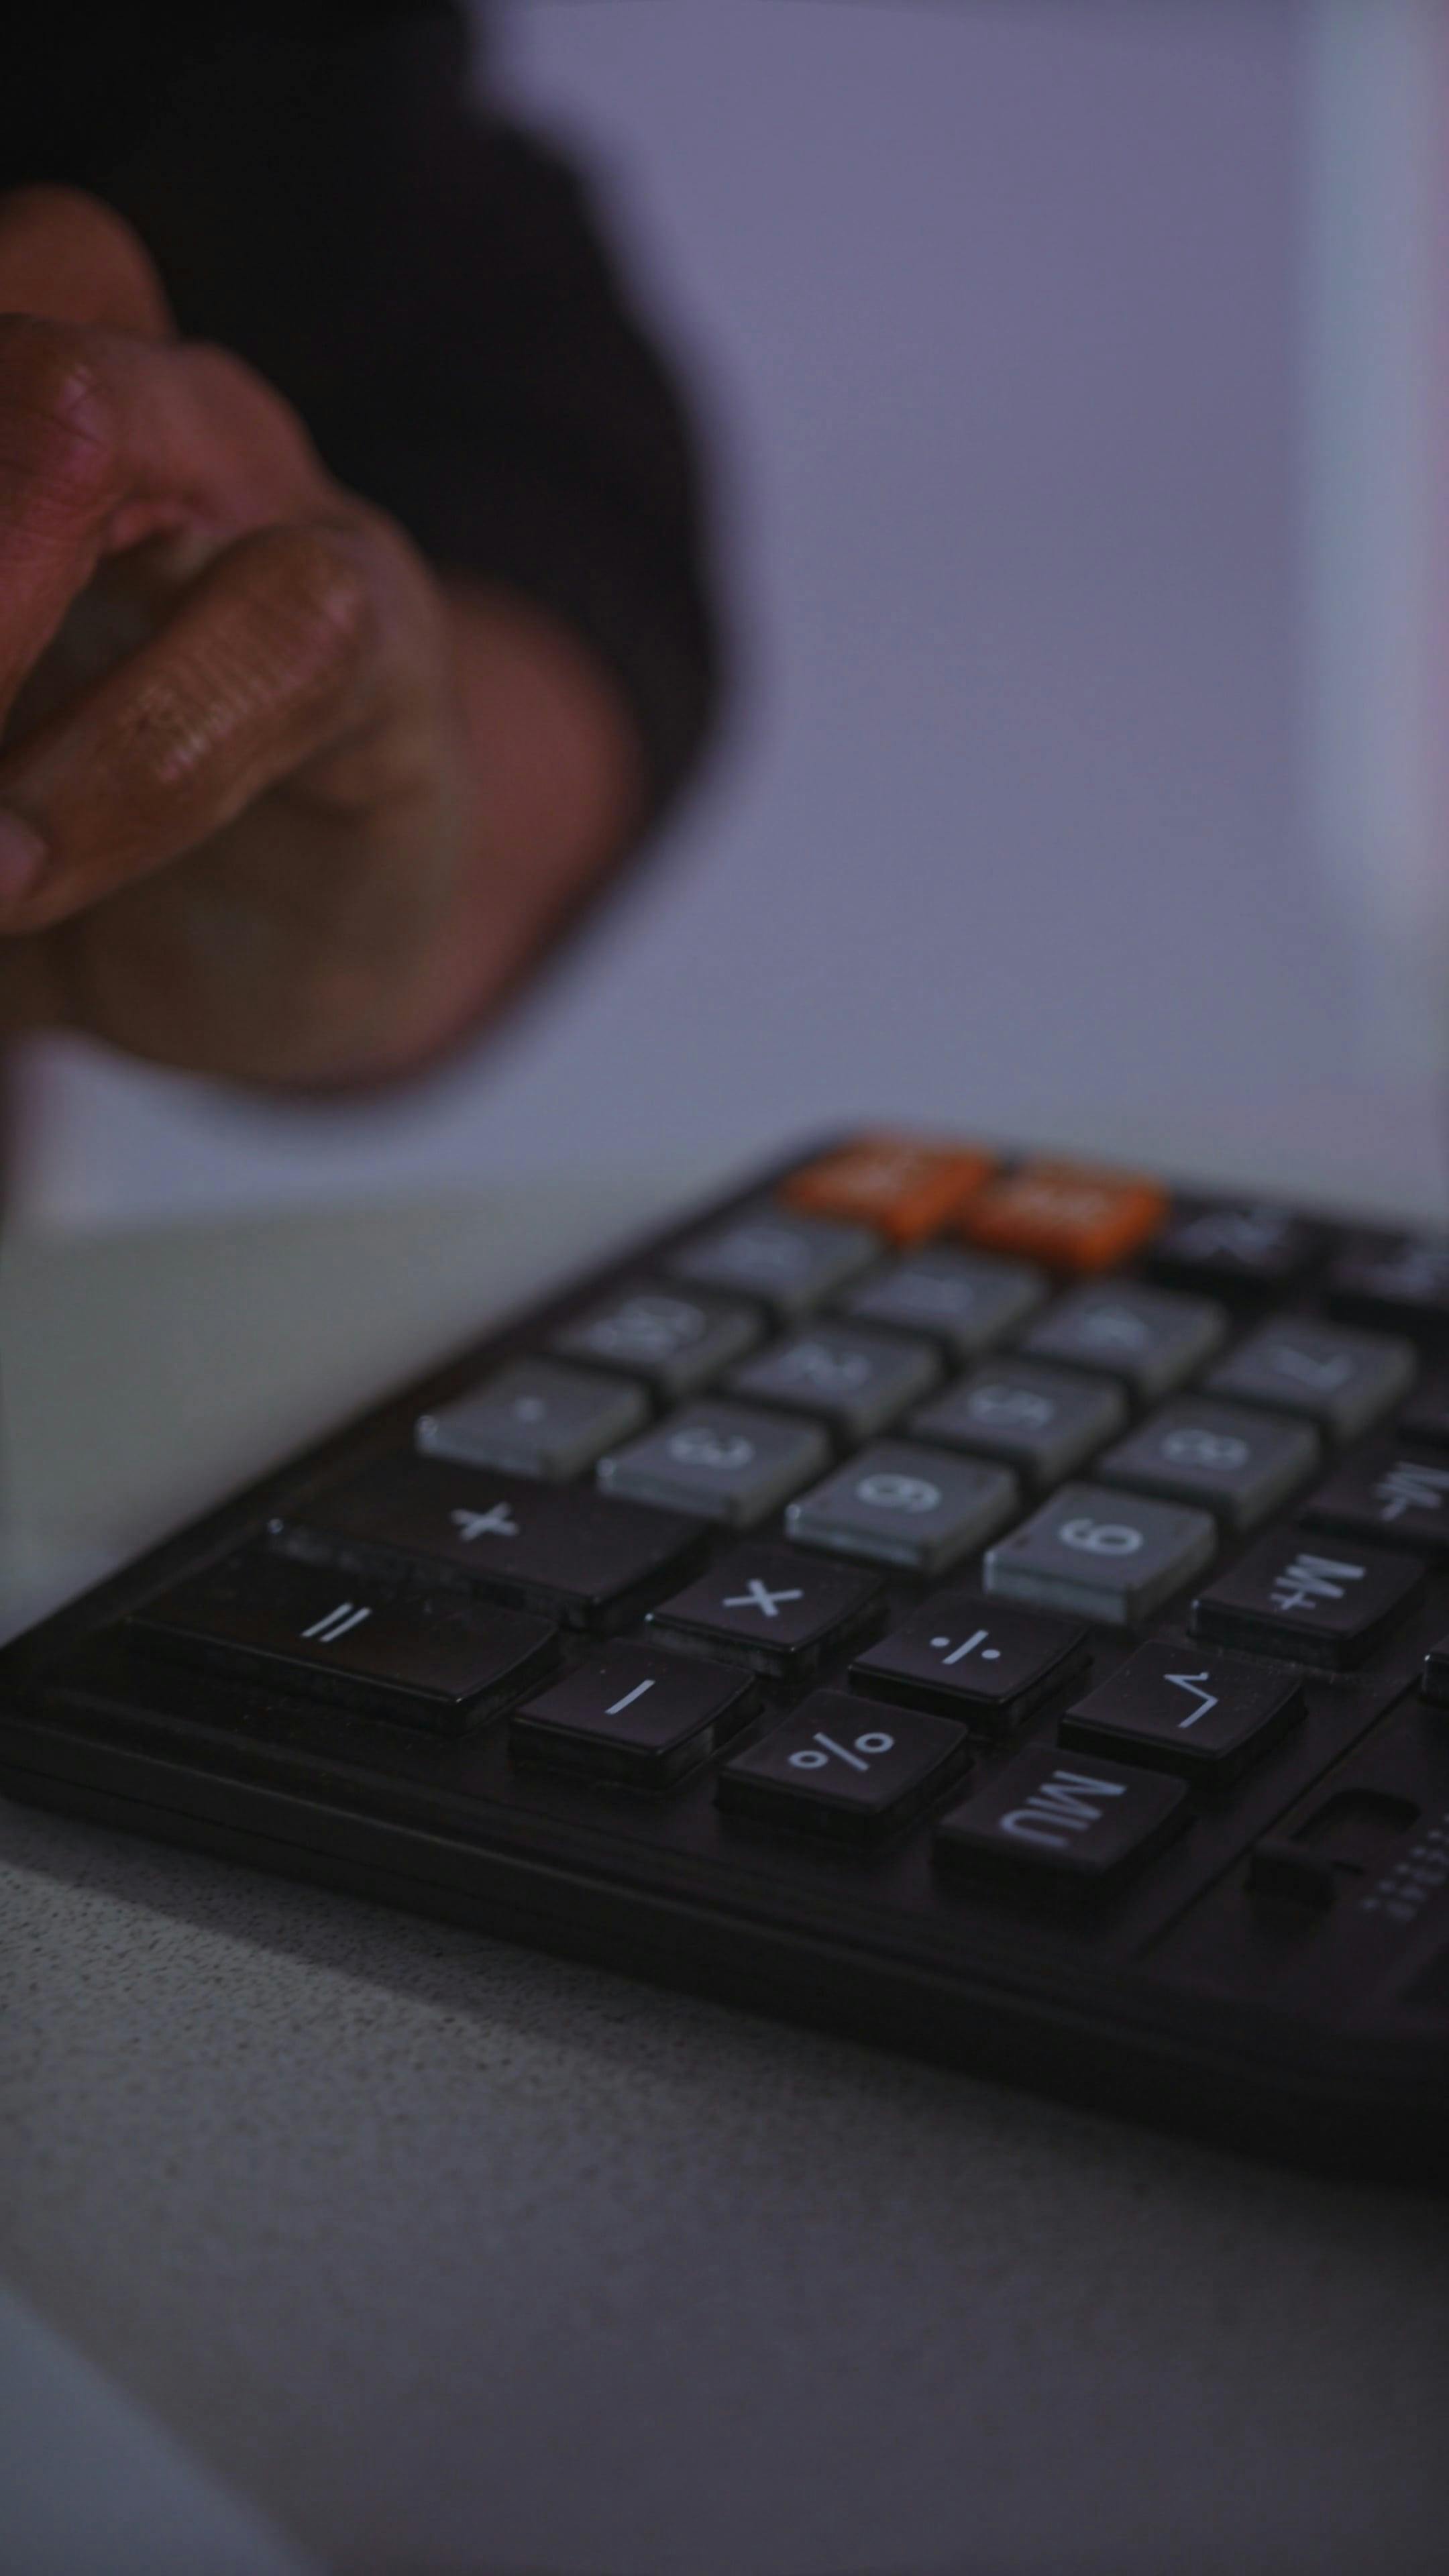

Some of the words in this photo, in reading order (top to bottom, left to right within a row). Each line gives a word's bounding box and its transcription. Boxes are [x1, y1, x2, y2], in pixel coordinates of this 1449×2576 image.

[669, 1427, 755, 1470] 3
[1162, 1429, 1248, 1469] 8
[856, 1474, 941, 1513] 6
[1058, 1517, 1142, 1556] 9
[1269, 1553, 1366, 1611] M+
[788, 1731, 895, 1772] %
[999, 1770, 1128, 1849] MU
